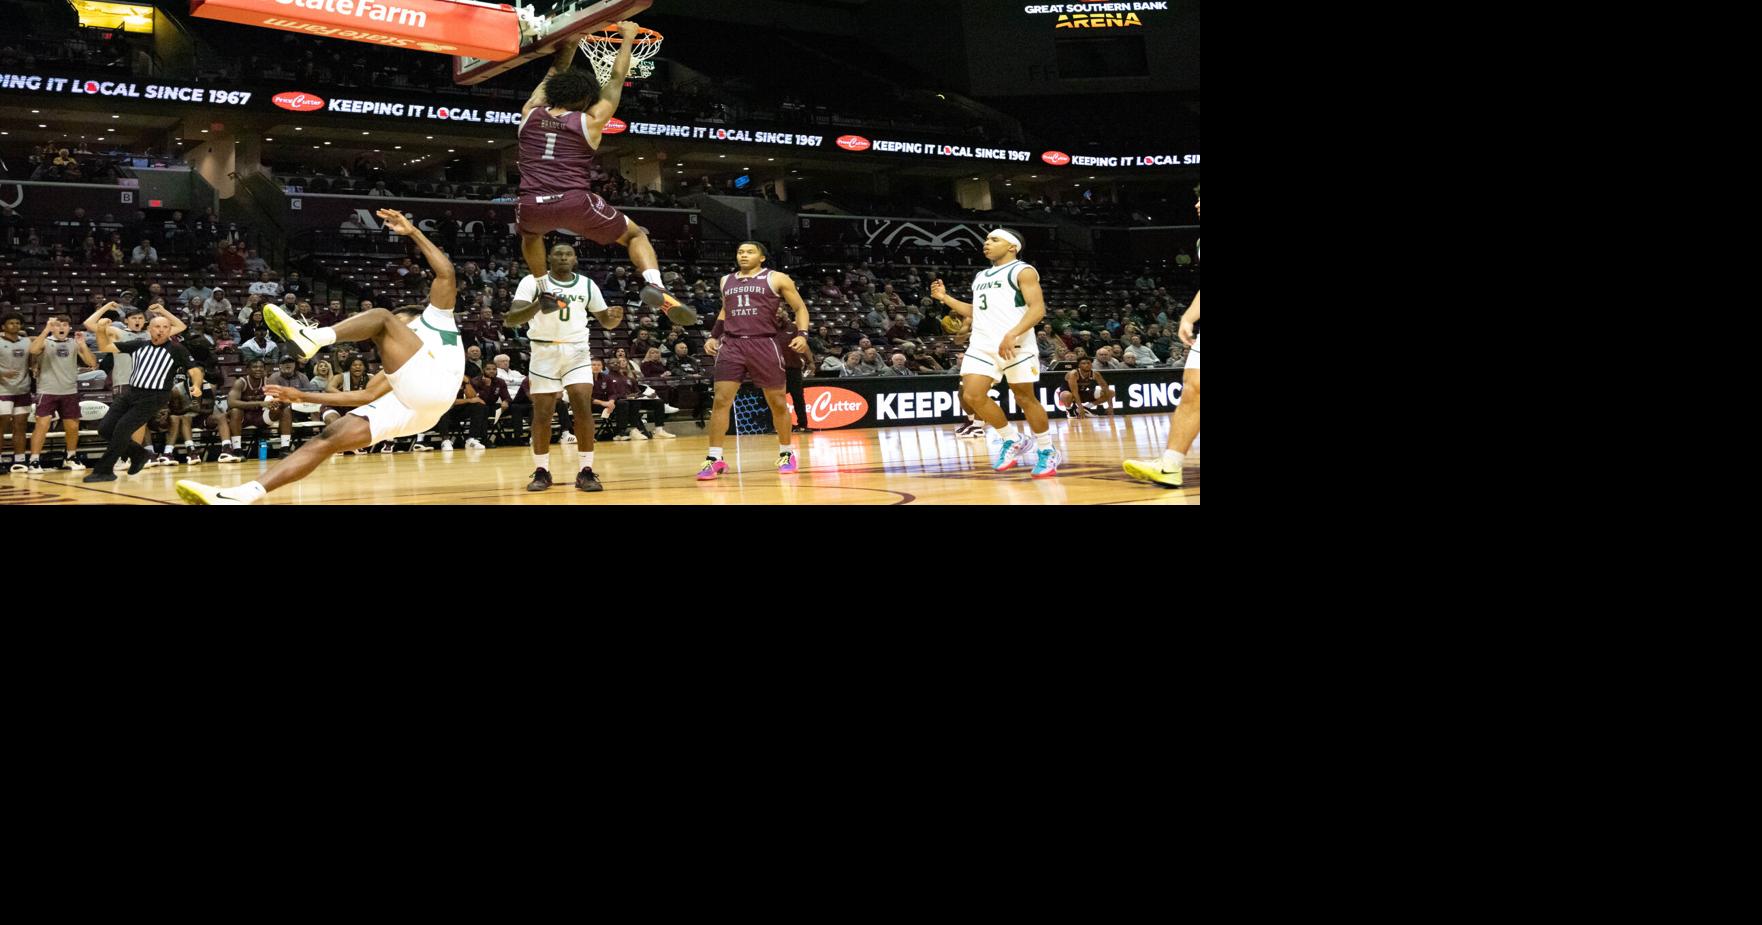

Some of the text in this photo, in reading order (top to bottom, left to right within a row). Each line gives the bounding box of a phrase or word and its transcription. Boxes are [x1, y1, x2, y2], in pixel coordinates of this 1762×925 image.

[1024, 1, 1168, 14] GREAT SOUTHERN BANK
[1055, 12, 1143, 28] ARENA
[46, 78, 68, 92] IT
[71, 80, 140, 97] LOCAL
[144, 84, 204, 102] SINCE
[208, 89, 251, 105] 1967
[328, 98, 522, 125] KEEPING IT LOCAL SINC
[629, 122, 690, 137] KEEPING
[693, 126, 706, 138] IT
[708, 127, 752, 142] LOCAL
[755, 131, 793, 144] SINCE
[795, 134, 823, 147] 1967
[541, 132, 557, 160] 1
[872, 140, 1031, 161] KEEPING IT LOCAL SINCE 1967
[1071, 155, 1117, 167] KEEPING
[1119, 157, 1134, 166] IT
[1136, 155, 1180, 166] LOCAL
[724, 285, 765, 297] MISSOURI
[736, 294, 751, 307] 11
[979, 293, 988, 310] 3
[559, 305, 570, 322] 0
[731, 308, 758, 317] STATE
[876, 386, 1001, 421] KEEPI
[1128, 382, 1183, 408] SINC
